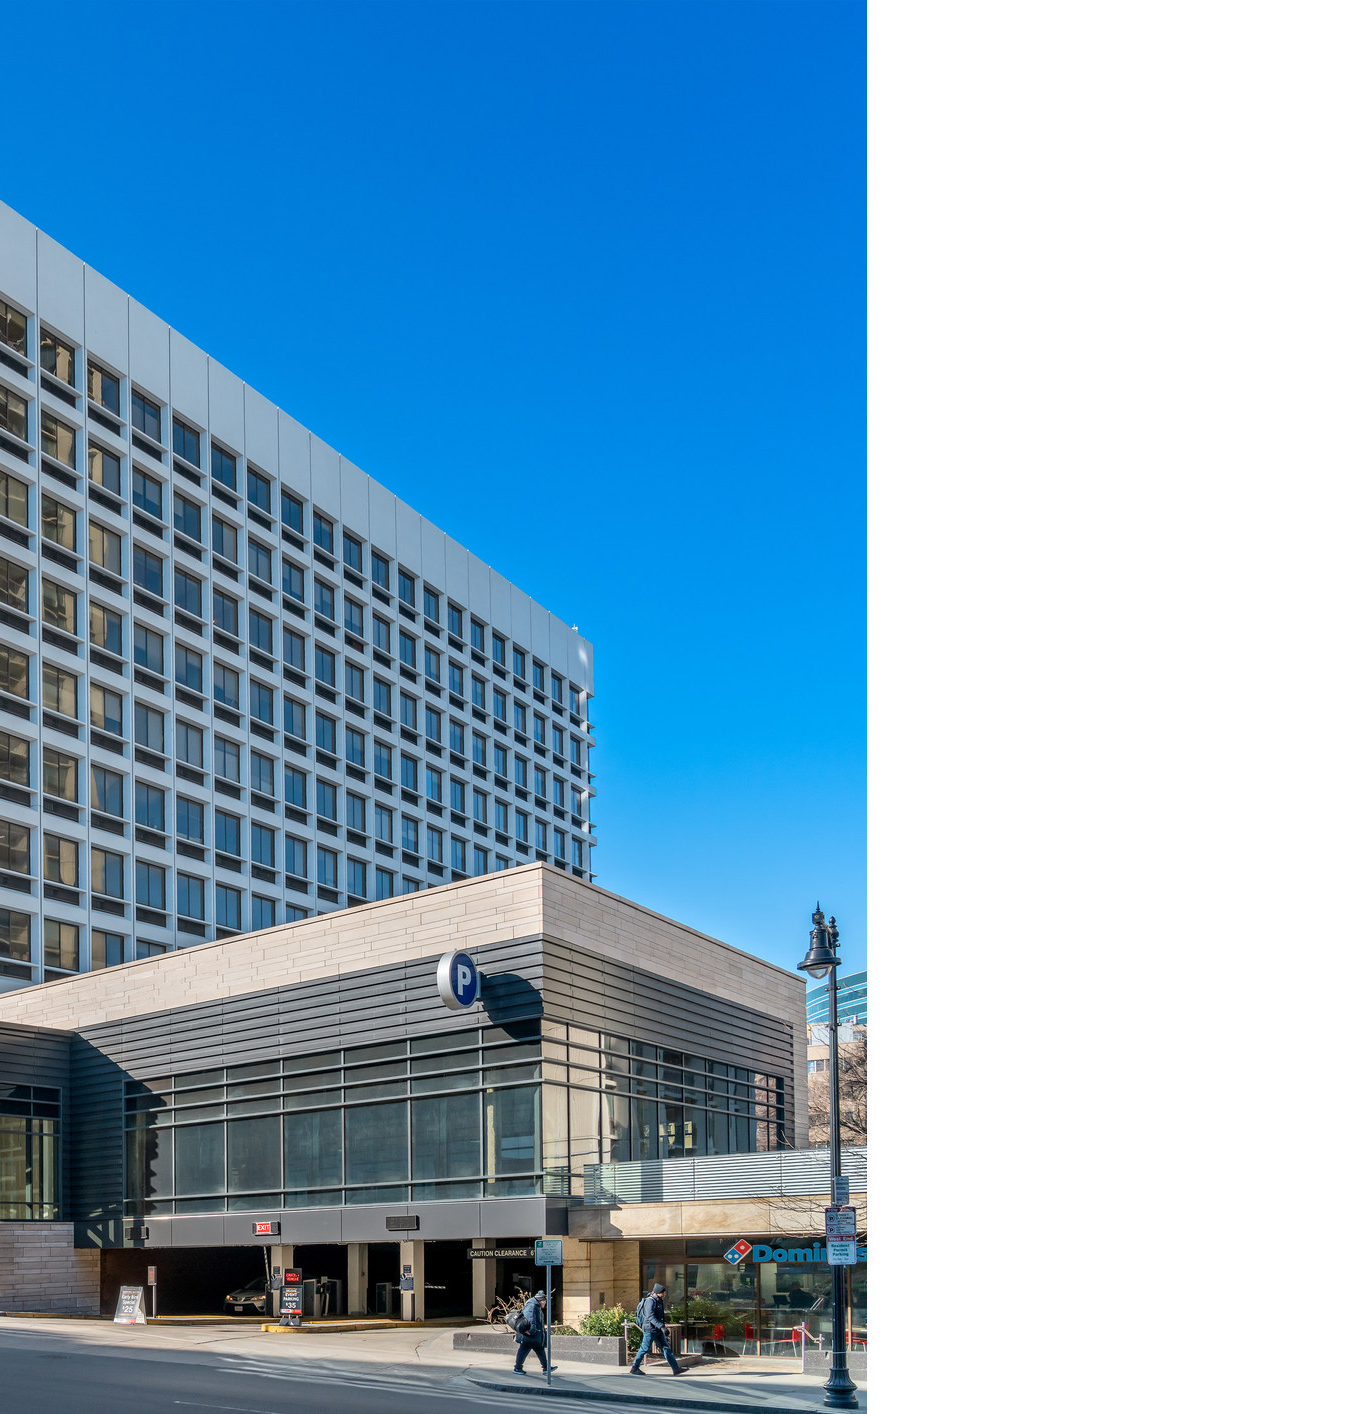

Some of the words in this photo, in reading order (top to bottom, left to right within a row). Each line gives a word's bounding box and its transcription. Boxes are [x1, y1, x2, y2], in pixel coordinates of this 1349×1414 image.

[457, 963, 472, 996] P
[494, 1249, 527, 1257] CLEARANCE
[752, 1242, 867, 1263] Domis
[122, 1305, 133, 1313] $25
